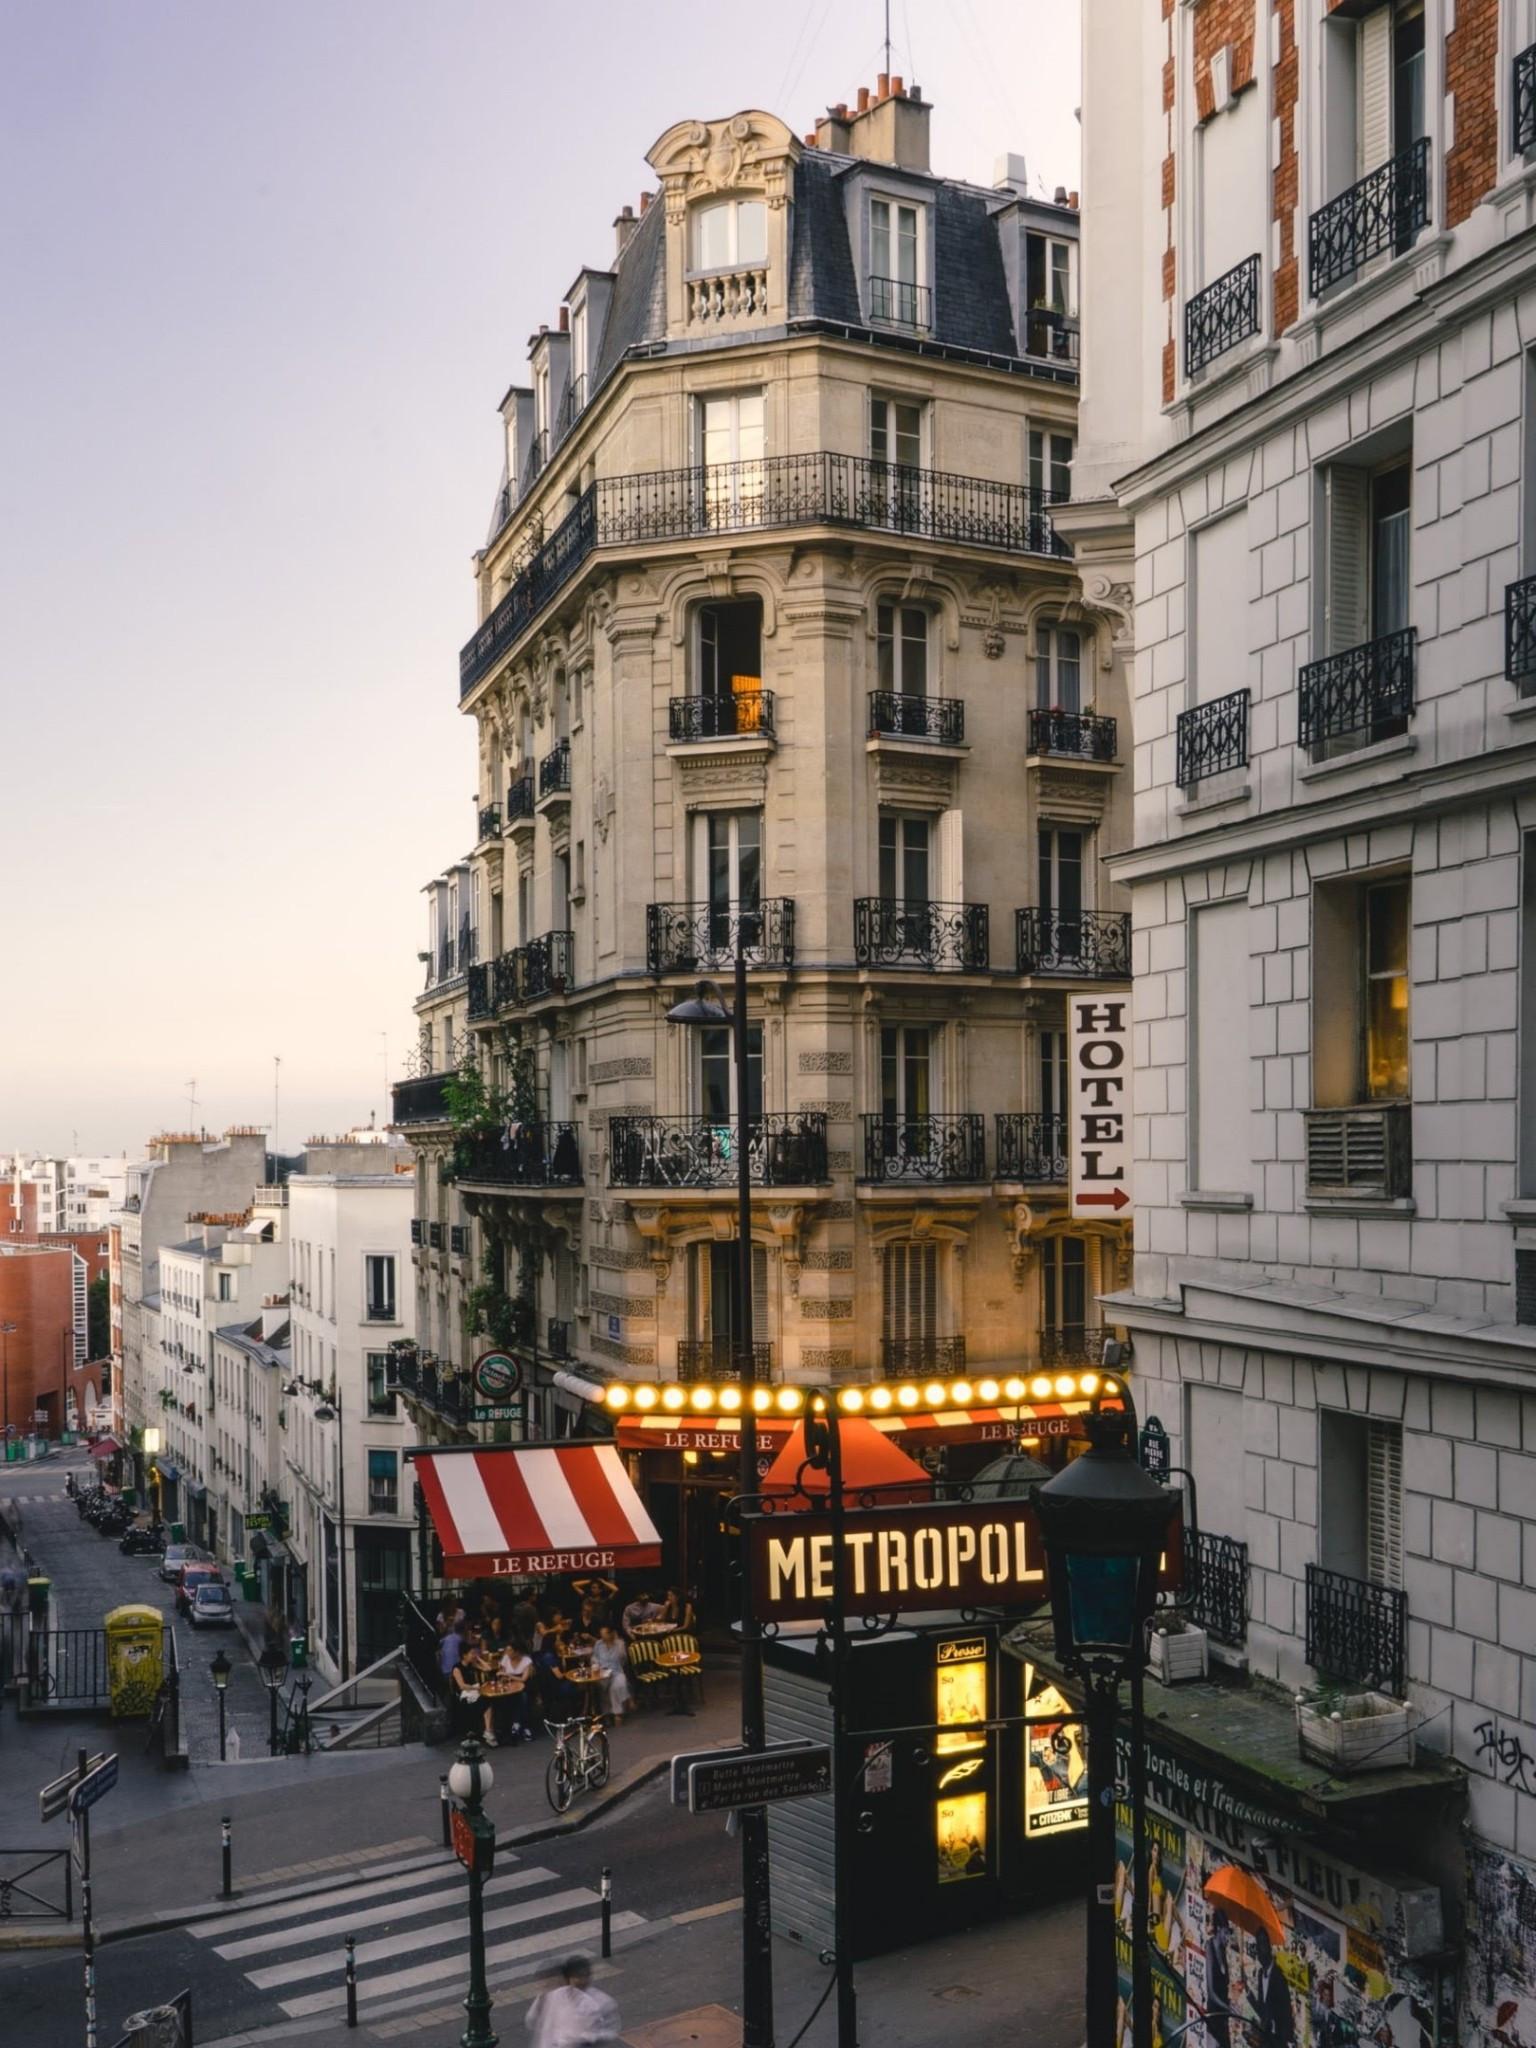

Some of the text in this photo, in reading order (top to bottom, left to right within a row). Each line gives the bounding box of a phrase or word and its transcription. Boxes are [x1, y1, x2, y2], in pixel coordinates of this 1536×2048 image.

[1076, 1002, 1126, 1181] HOTEL
[488, 1407, 523, 1420] REFUGE
[664, 1432, 773, 1450] LE REFUE
[981, 1426, 1002, 1440] LE
[493, 1552, 615, 1574] LE REFUGE
[768, 1520, 1166, 1601] METROPOL
[940, 1643, 983, 1659] Presse
[1143, 1743, 1190, 1792] lorales
[1193, 1777, 1207, 1802] et
